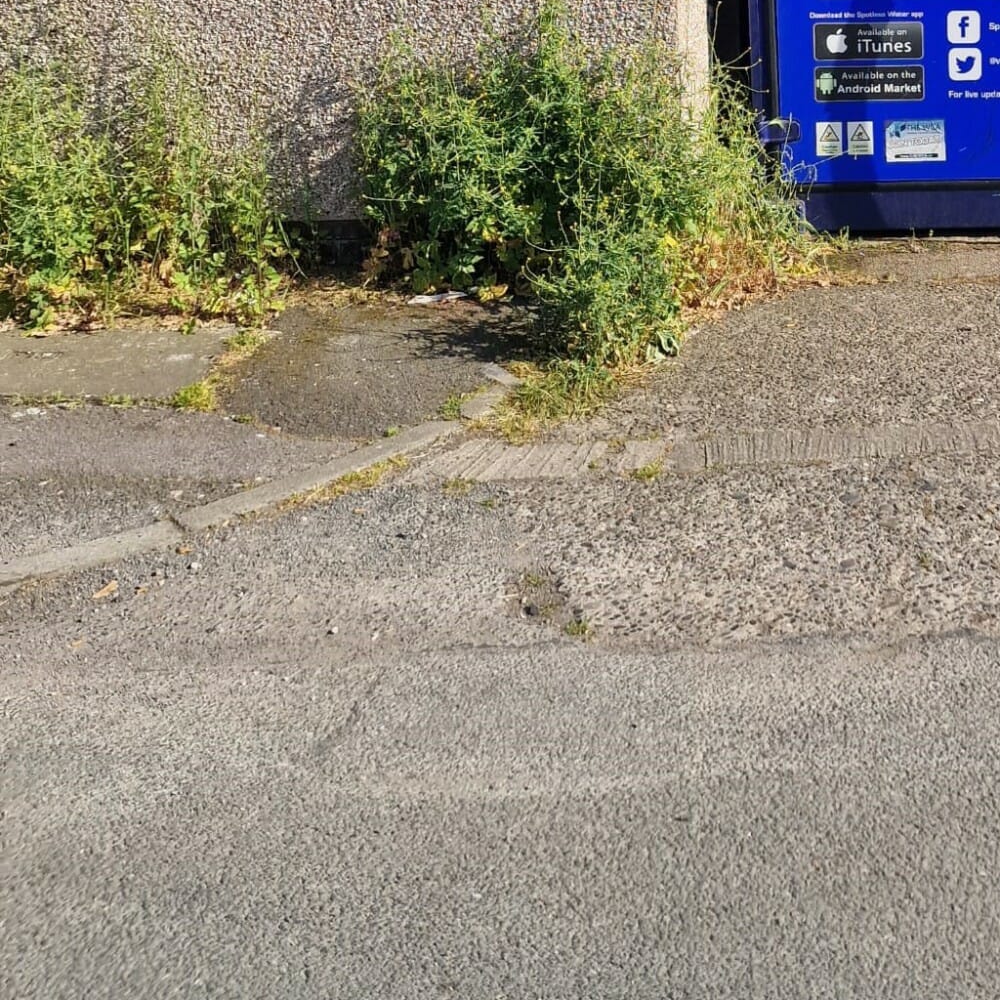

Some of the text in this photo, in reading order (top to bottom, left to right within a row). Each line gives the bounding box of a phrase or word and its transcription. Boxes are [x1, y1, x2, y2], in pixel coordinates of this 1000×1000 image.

[857, 28, 894, 36] Available
[857, 38, 912, 54] iTunes
[841, 70, 916, 80] Available on the
[837, 82, 922, 94] Android Market
[948, 90, 963, 98] For
[964, 90, 979, 98] live
